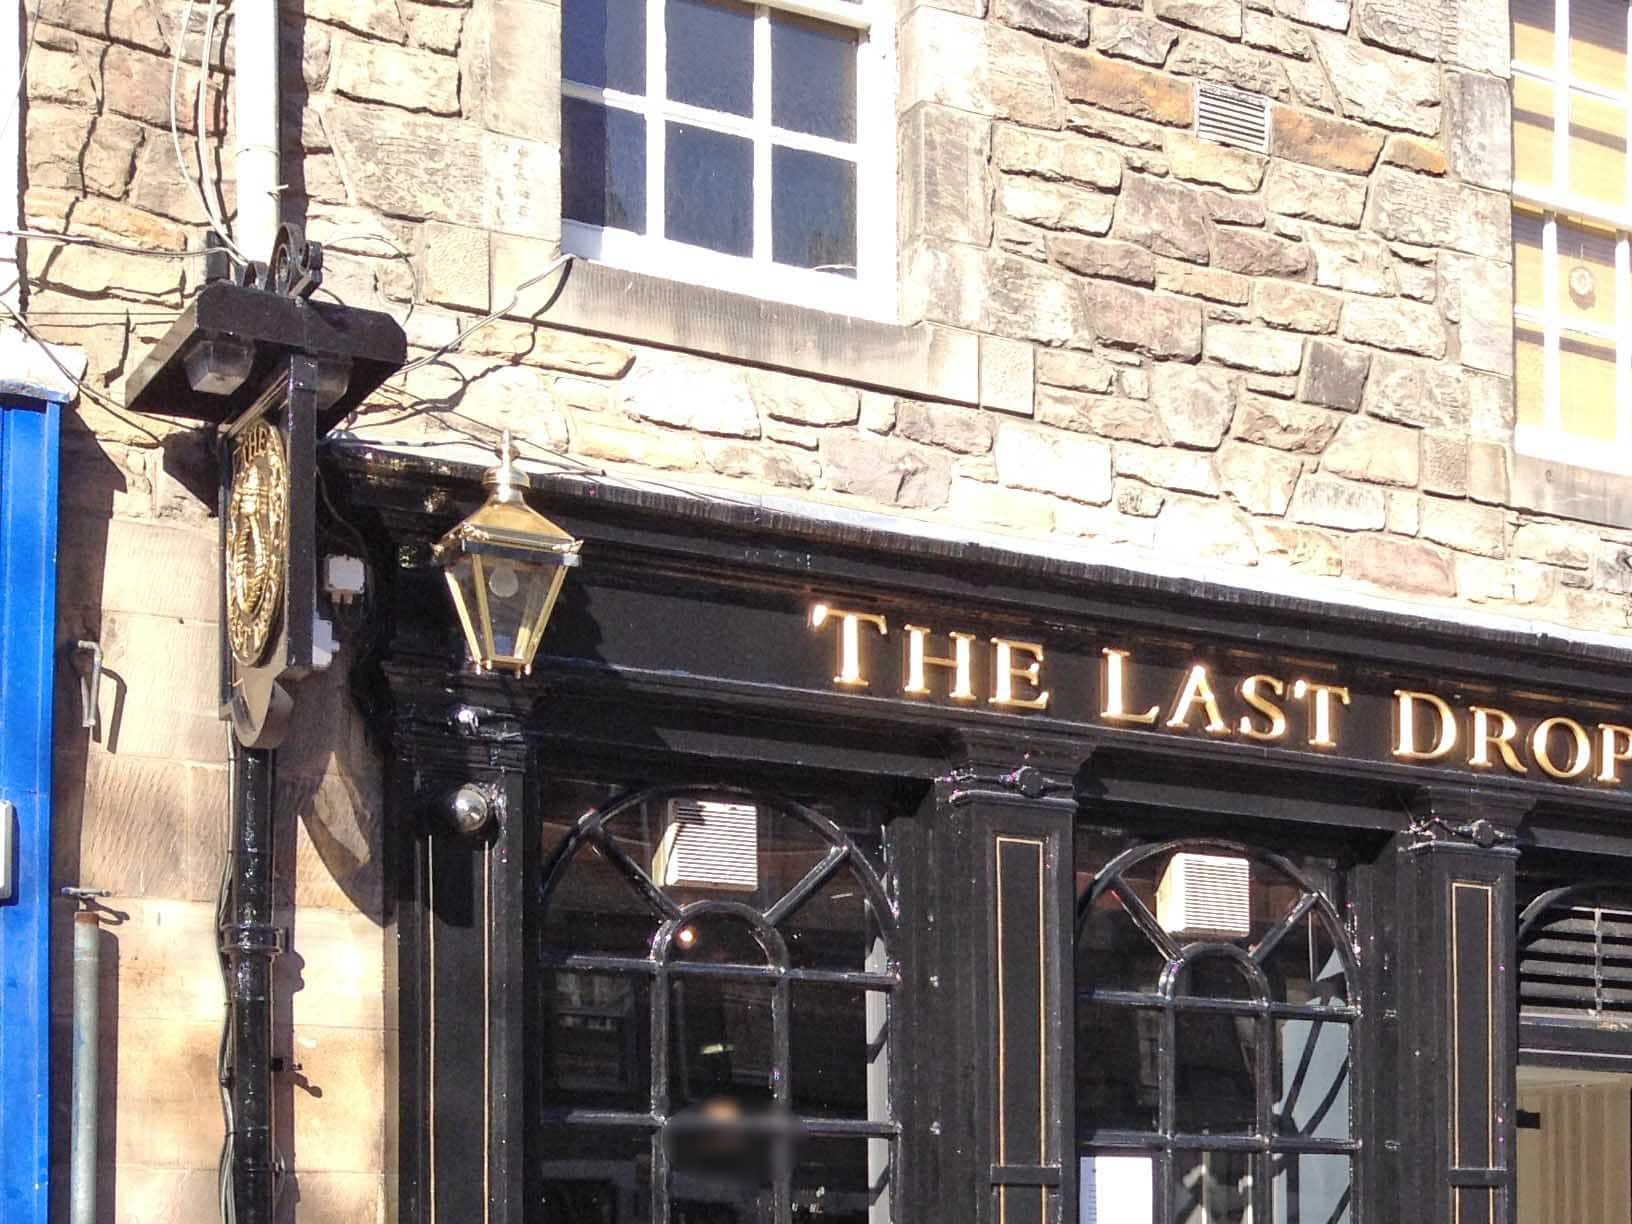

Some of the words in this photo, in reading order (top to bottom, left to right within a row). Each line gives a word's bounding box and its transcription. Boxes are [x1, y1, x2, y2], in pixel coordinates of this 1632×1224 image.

[242, 427, 268, 467] THE
[811, 602, 1050, 710] THE
[1100, 646, 1353, 748] LAST
